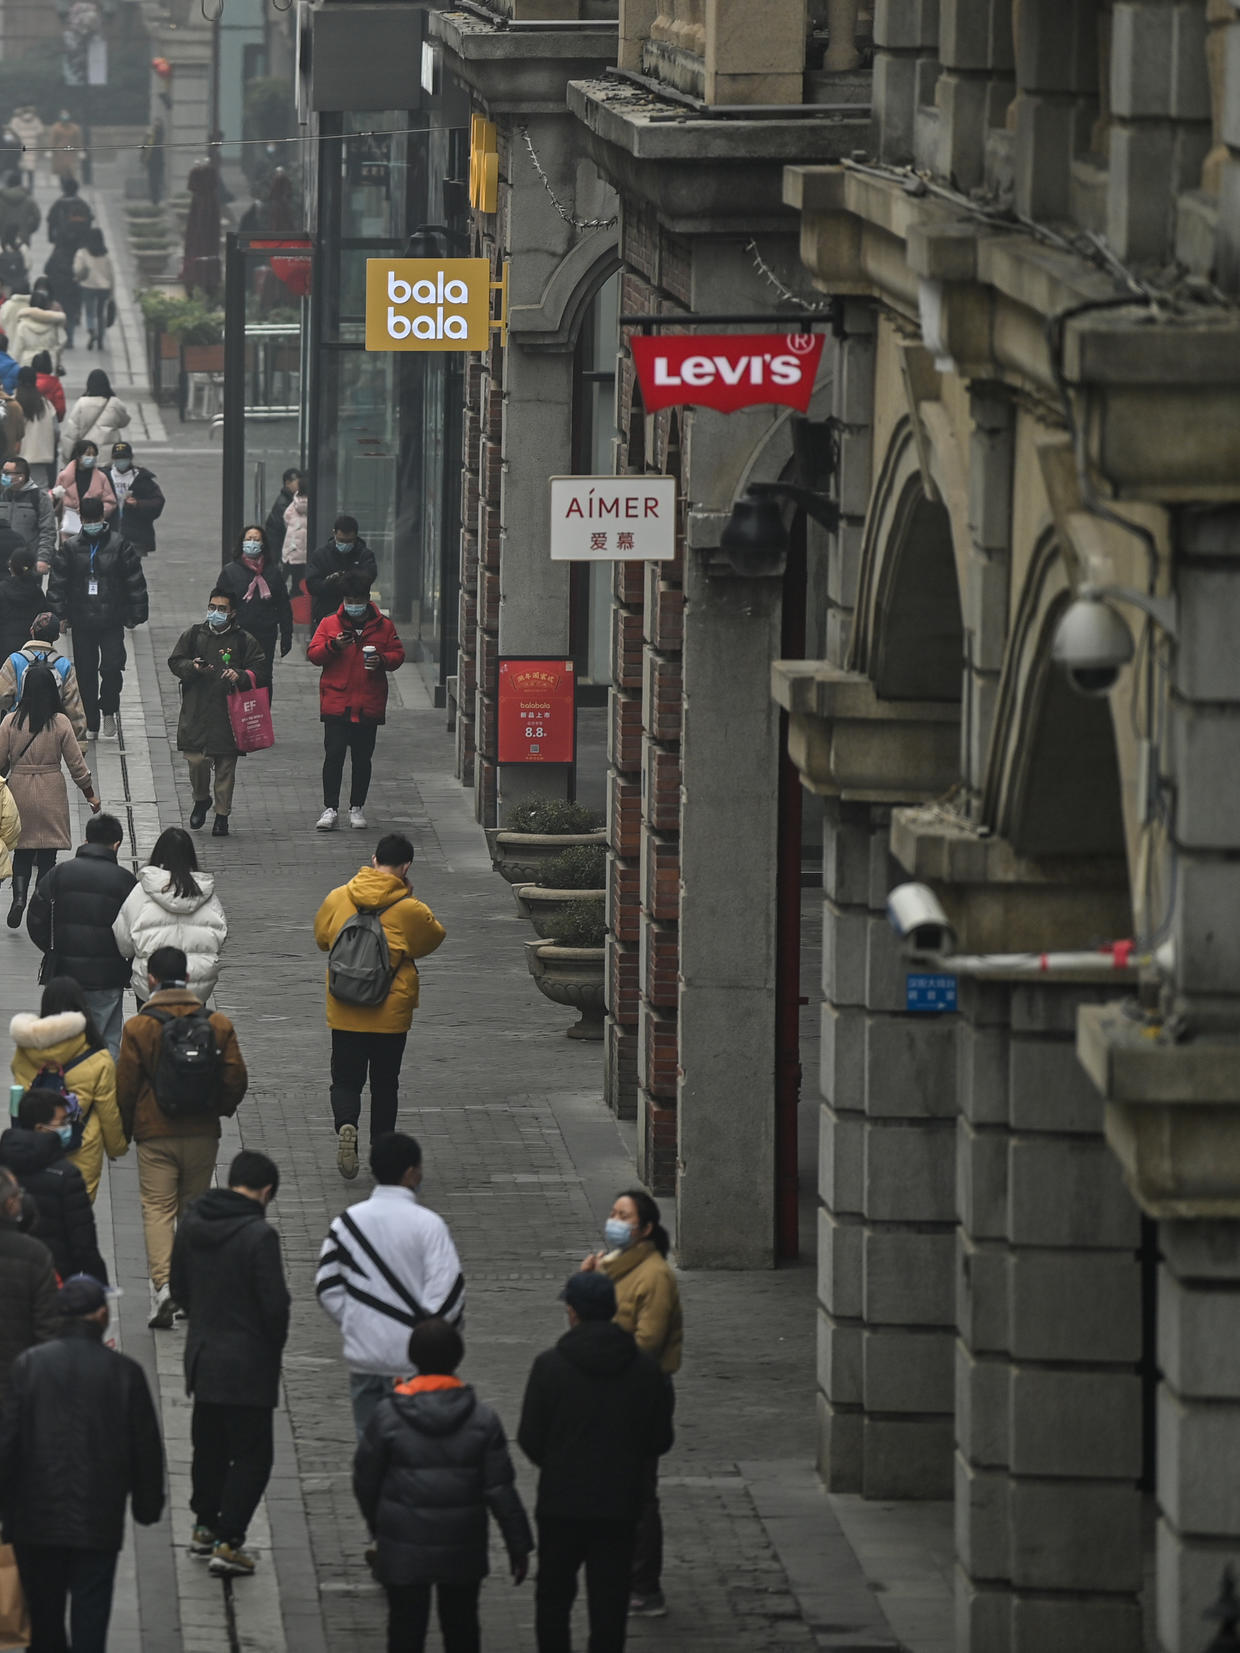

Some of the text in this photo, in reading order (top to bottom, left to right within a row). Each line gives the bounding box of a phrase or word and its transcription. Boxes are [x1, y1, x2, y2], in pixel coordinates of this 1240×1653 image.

[387, 271, 468, 304] bala
[387, 306, 468, 340] bala
[565, 487, 659, 518] AÍMER
[590, 531, 635, 551] 爱慕
[243, 700, 256, 713] EF
